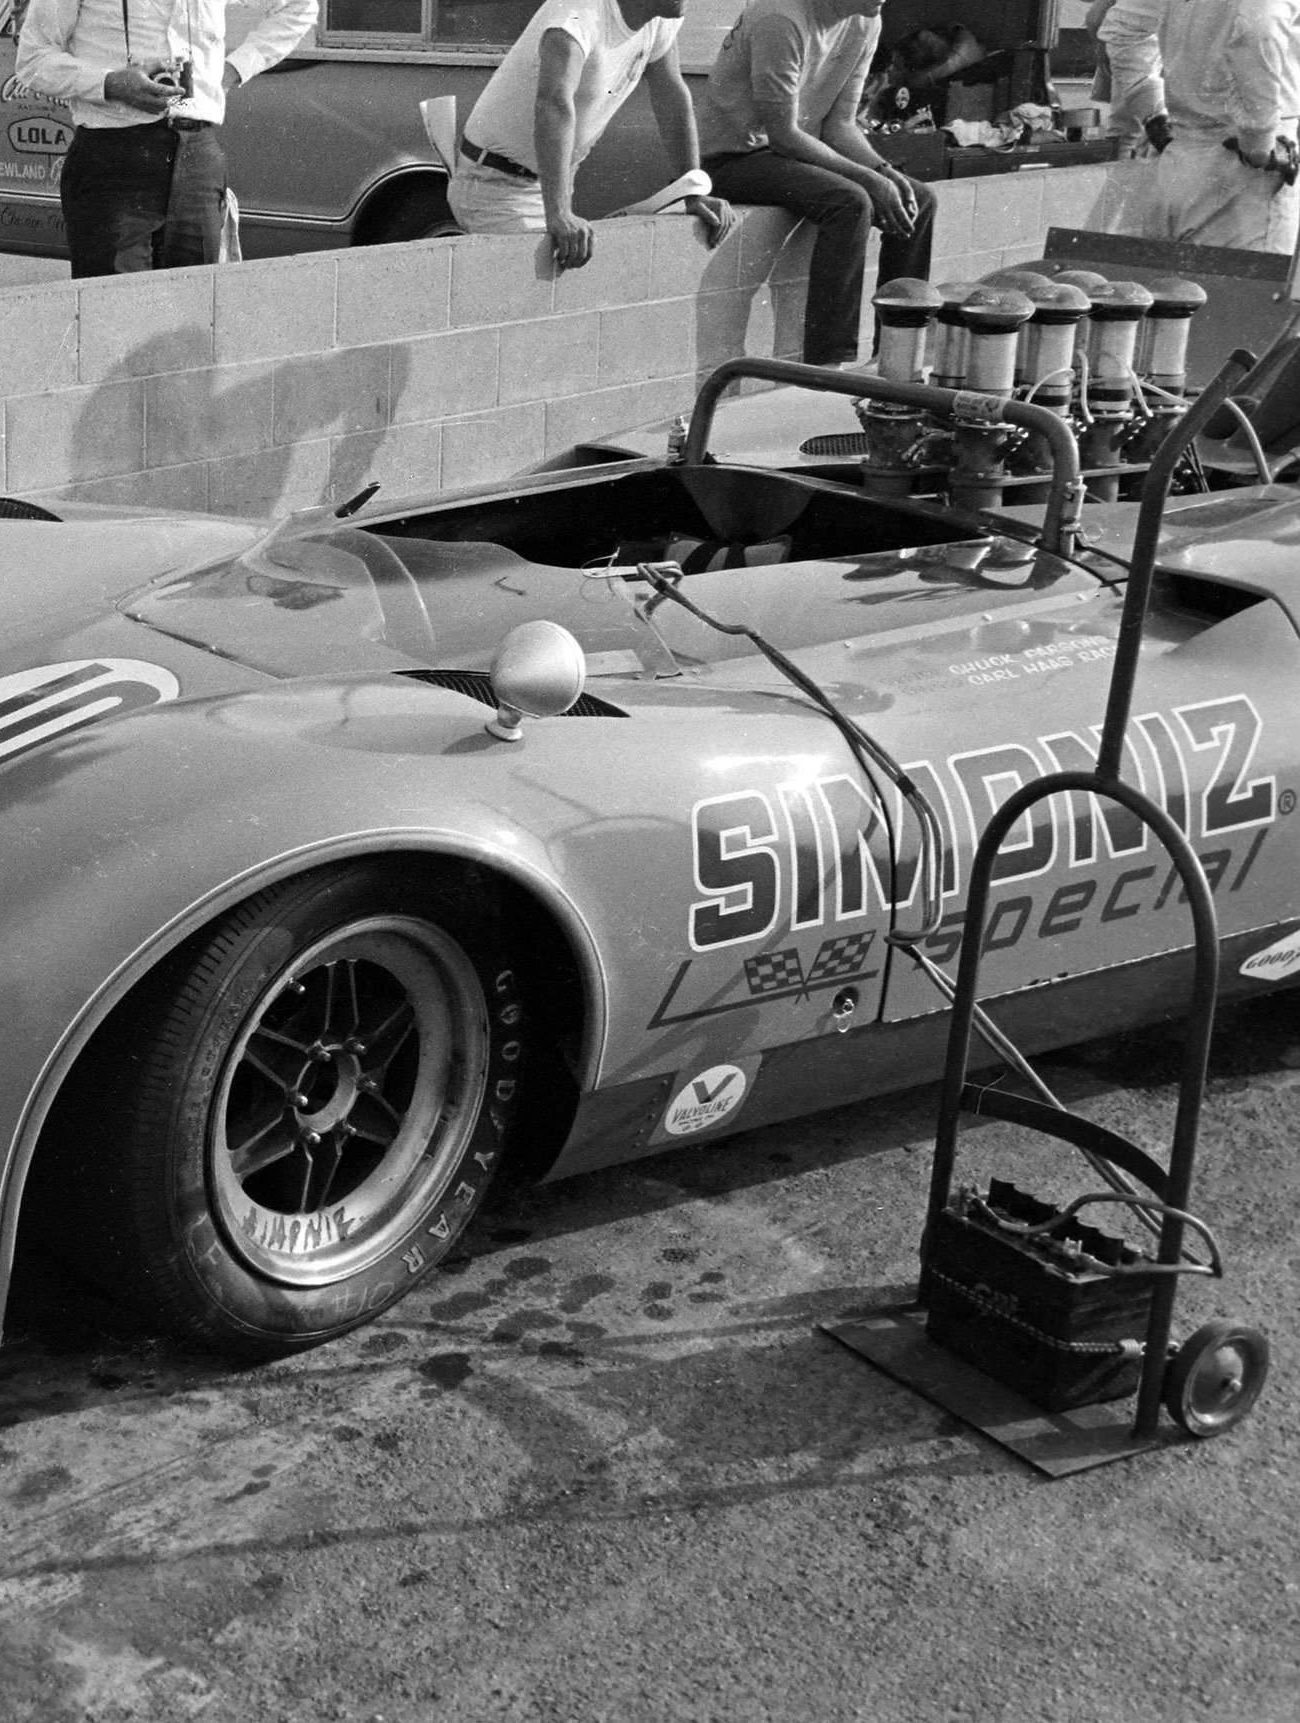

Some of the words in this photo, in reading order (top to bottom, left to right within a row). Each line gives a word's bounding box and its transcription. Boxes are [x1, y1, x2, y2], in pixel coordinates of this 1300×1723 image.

[17, 127, 67, 145] LOLA
[949, 654, 1018, 676] CHUCK
[967, 668, 1020, 686] CARL
[1022, 655, 1074, 676] HAAS
[1080, 645, 1119, 664] RAC
[688, 693, 1277, 953] SIMONIZ
[1246, 949, 1300, 970] GOOD
[672, 1095, 734, 1125] VALVOLINE
